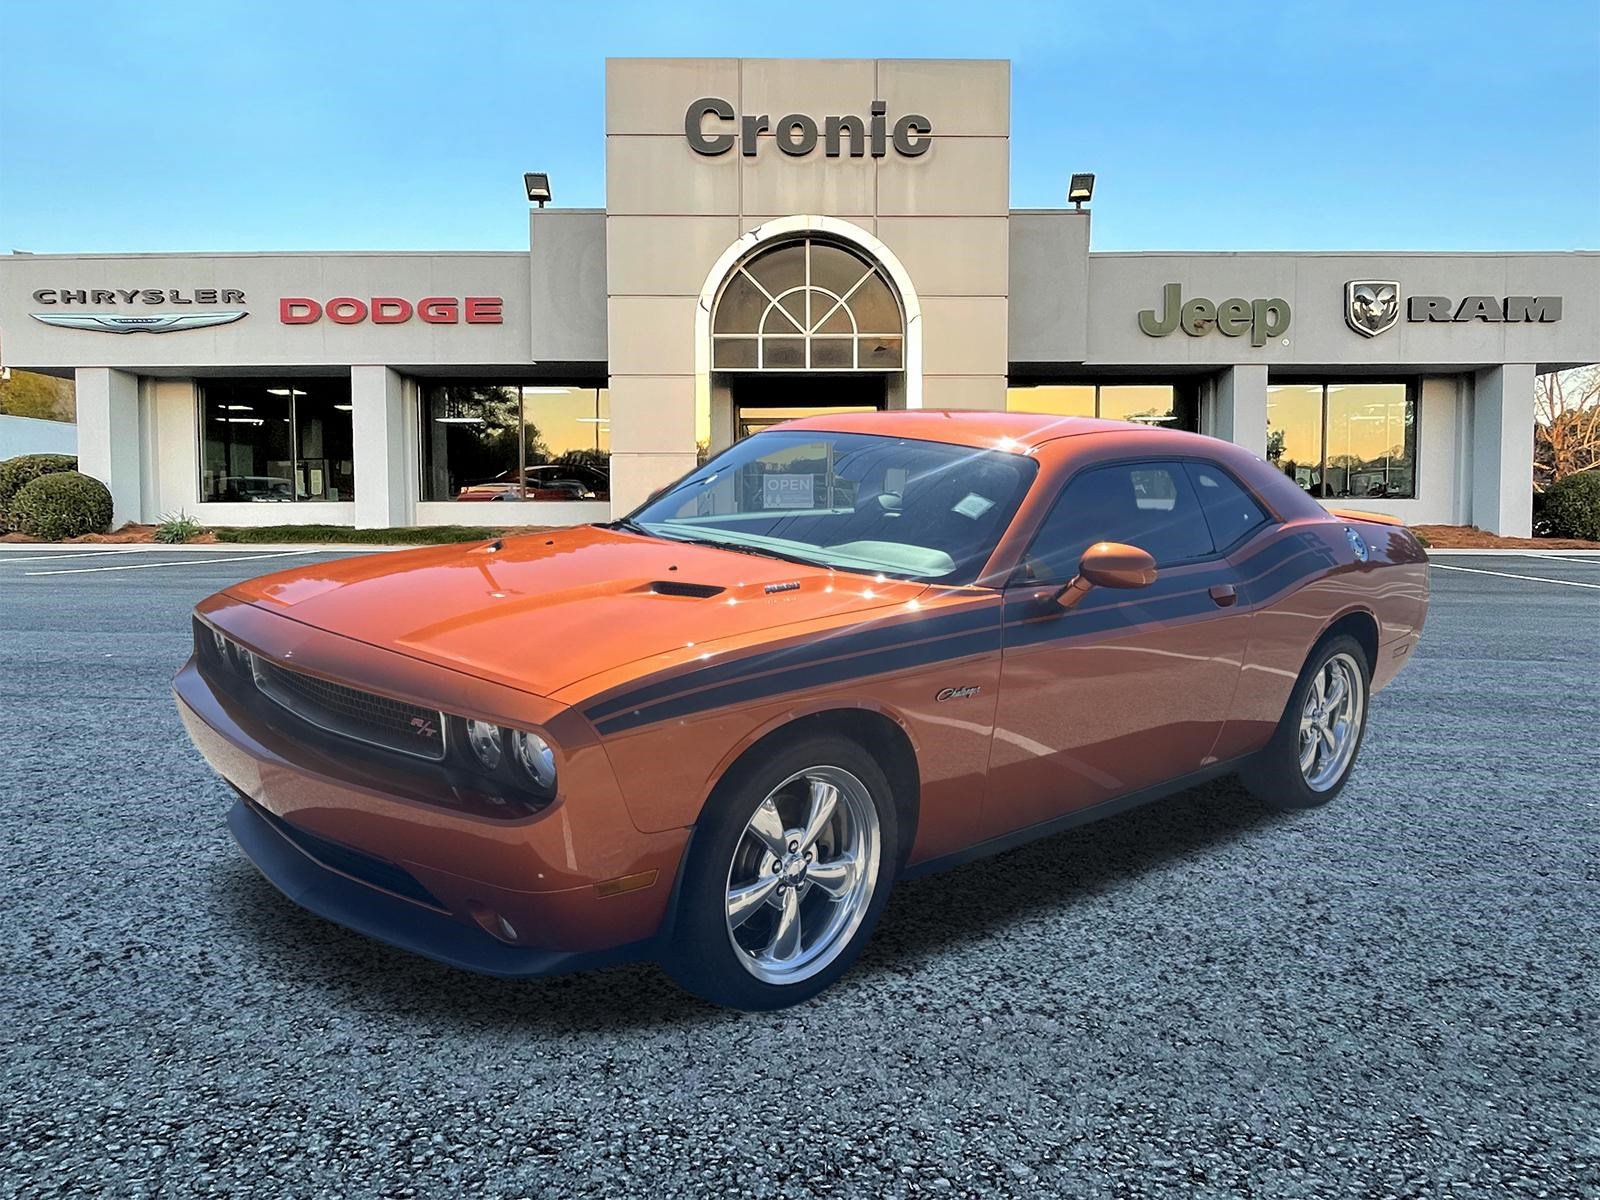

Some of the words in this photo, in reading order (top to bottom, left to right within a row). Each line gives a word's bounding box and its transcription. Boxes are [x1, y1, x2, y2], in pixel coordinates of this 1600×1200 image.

[685, 97, 932, 158] Cronic
[32, 288, 246, 305] CHRYSLER
[1407, 295, 1563, 323] RAM
[279, 297, 503, 325] DODGE
[1138, 283, 1291, 348] Jeep
[767, 479, 810, 491] OPEN
